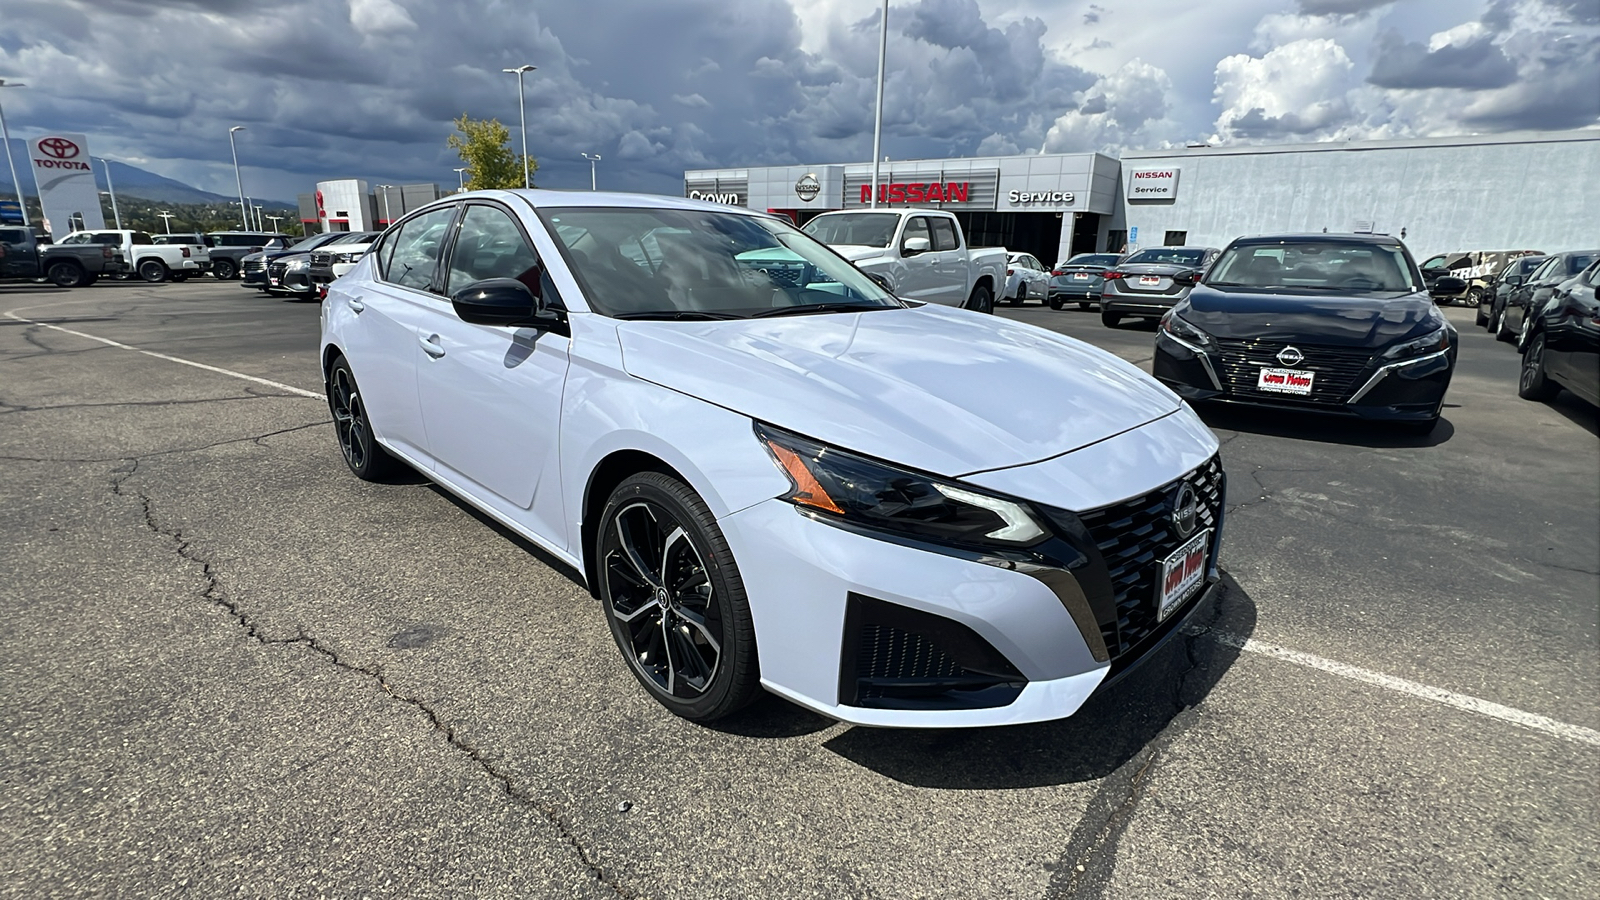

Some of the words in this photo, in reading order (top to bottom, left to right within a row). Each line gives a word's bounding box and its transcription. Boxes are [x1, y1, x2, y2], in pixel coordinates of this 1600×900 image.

[34, 159, 91, 171] TOYOTA
[690, 190, 738, 205] Crown
[860, 182, 969, 203] NISSAN
[1008, 189, 1074, 202] Service
[1163, 598, 1182, 617] CROWN
[1182, 579, 1202, 600] MOTORS
